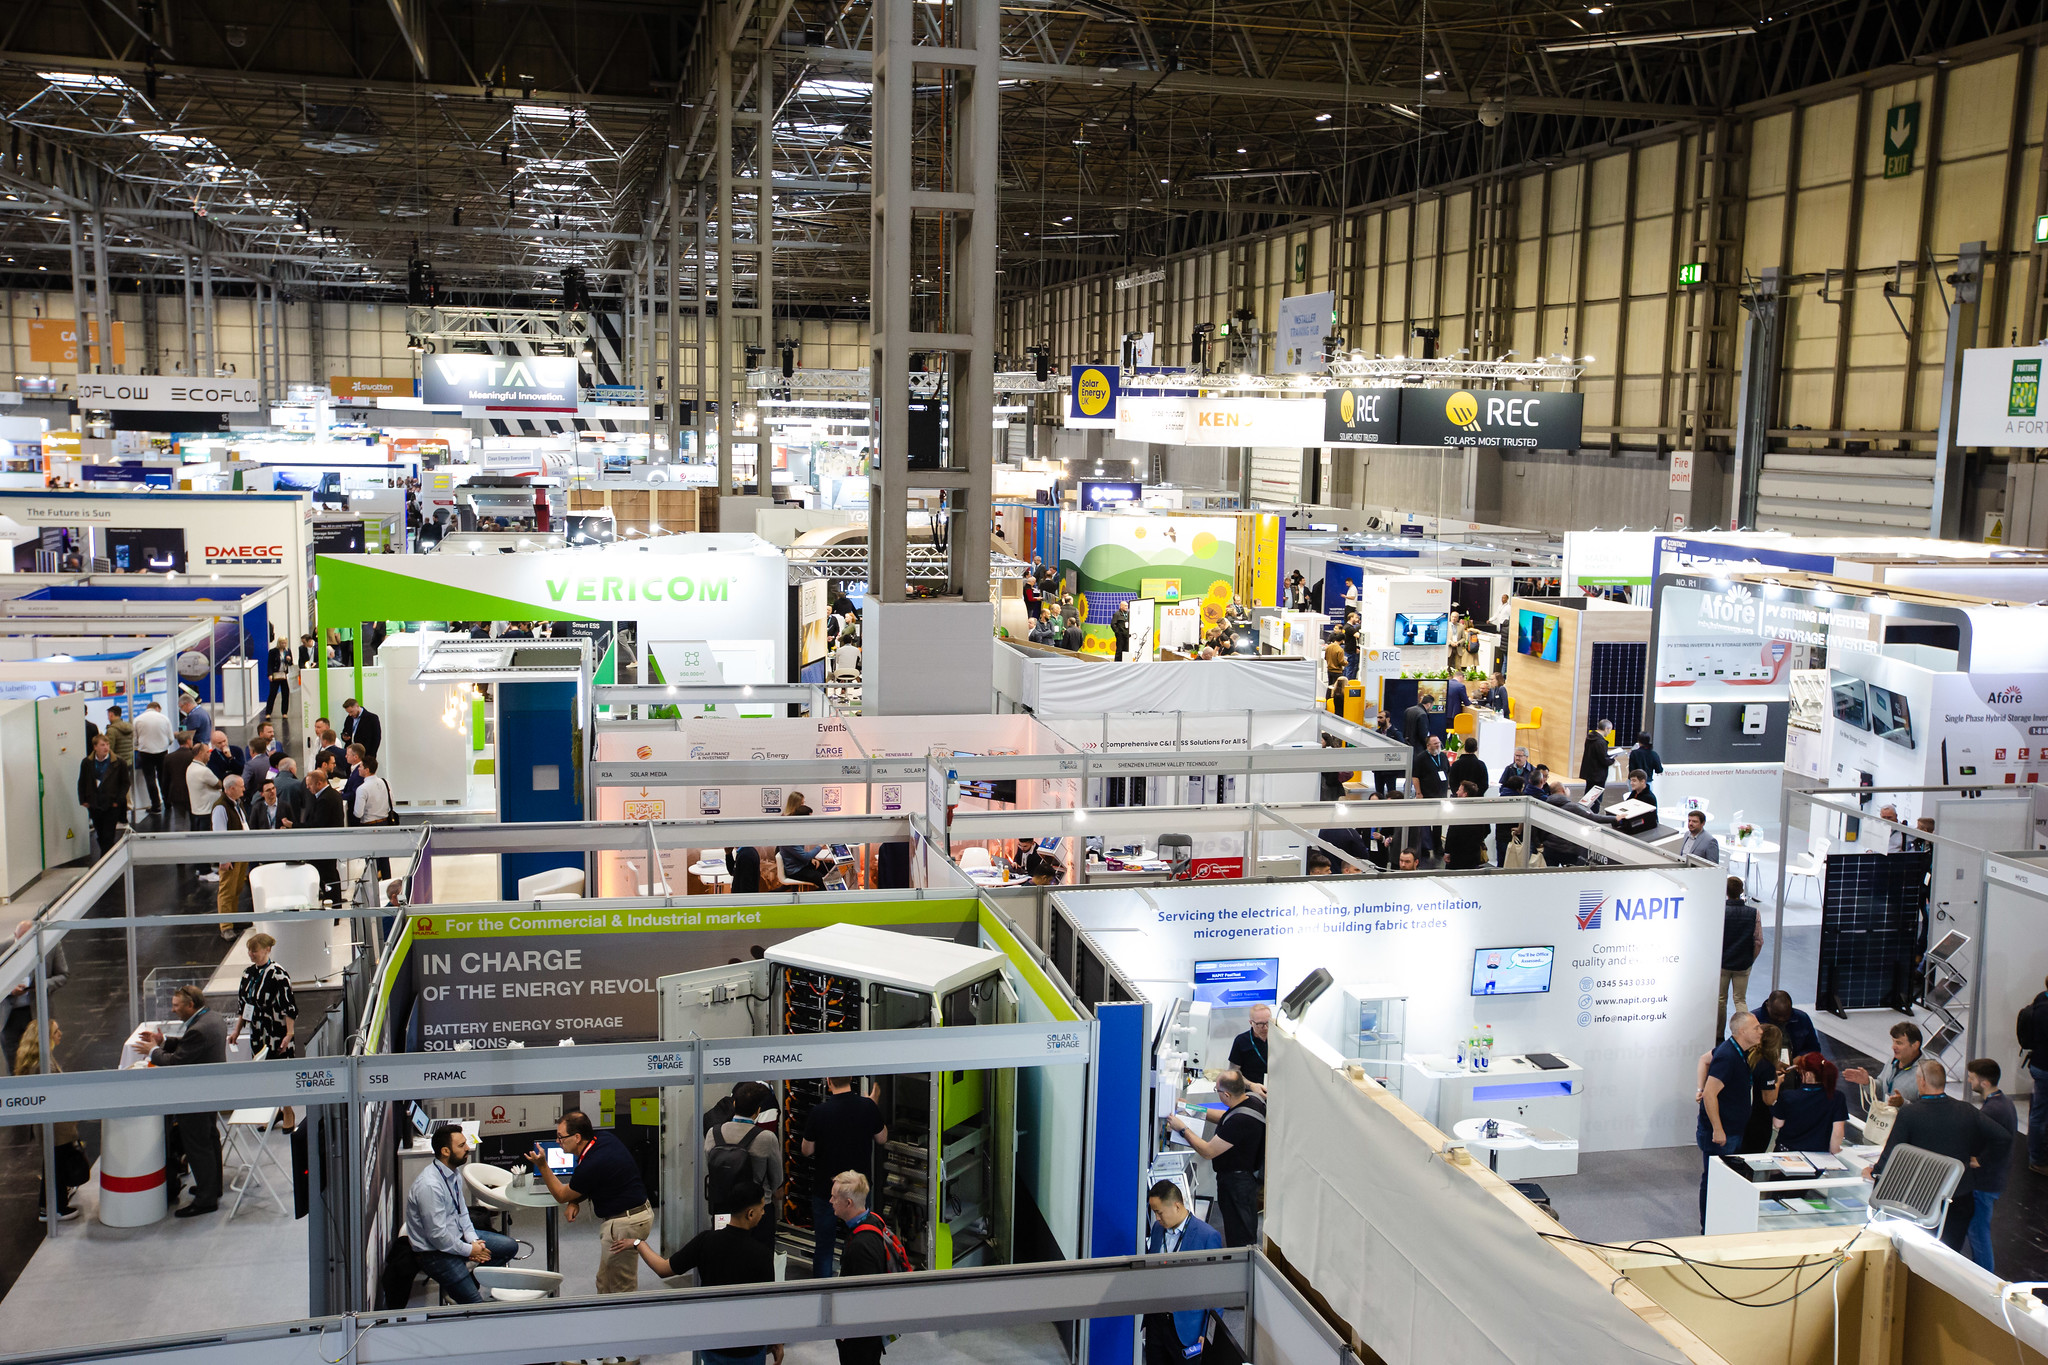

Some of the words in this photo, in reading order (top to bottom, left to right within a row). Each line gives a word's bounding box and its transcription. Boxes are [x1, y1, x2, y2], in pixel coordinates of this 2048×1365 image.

[1887, 154, 1910, 177] EXIT
[1081, 379, 1099, 388] Solar
[2013, 375, 2038, 383] GLOBAL
[171, 387, 257, 402] ECOFLO
[469, 391, 516, 401] Meaningful
[518, 391, 566, 401] Innovation.
[1081, 388, 1106, 399] Energy
[2010, 382, 2038, 408] 500
[1356, 395, 1381, 423] REC
[1486, 398, 1541, 427] REC
[1199, 412, 1254, 427] KEN
[2005, 421, 2014, 433] A
[1443, 436, 1476, 445] SOLAR'S
[1478, 437, 1500, 445] MOST
[1503, 438, 1537, 447] TRUSTED
[1674, 456, 1690, 470] Fire
[1671, 470, 1691, 485] point
[27, 508, 45, 516] The
[48, 508, 80, 517] Future
[82, 508, 90, 516] is
[92, 509, 111, 517] Sun
[1667, 539, 1687, 548] CONTACT
[205, 545, 283, 557] DMEGC
[545, 576, 729, 602] VERICOM
[839, 580, 856, 592] 1.6
[1675, 579, 1688, 587] NO.
[1167, 607, 1196, 616] KENO
[1700, 593, 1756, 624] Afore
[1765, 604, 1779, 617] PV
[1780, 607, 1817, 623] STRING
[1818, 612, 1870, 631] INVERTER
[1764, 625, 1778, 638] PV
[1779, 627, 1826, 646] STORAGE
[1826, 635, 1879, 653] INVERTER
[1382, 651, 1401, 661] REC
[1987, 691, 2022, 704] Afore
[1945, 714, 1964, 723] Single
[1965, 714, 1984, 722] Phase
[1985, 714, 2006, 723] Hybrid
[2007, 714, 2031, 723] Storage
[2033, 714, 2048, 722] Inver
[817, 723, 847, 733] Events
[766, 752, 789, 760] Energy
[1735, 768, 1777, 776] Manufacturing
[1158, 909, 1215, 923] Servicing
[1218, 908, 1238, 919] the
[1240, 905, 1299, 919] electrical,
[1302, 904, 1351, 917] heating,
[1353, 901, 1414, 917] plumbing,
[1416, 899, 1482, 912] ventilation,
[1615, 896, 1685, 921] NAPIT
[446, 918, 473, 932] For
[477, 918, 504, 931] the
[509, 913, 607, 930] Commercial
[611, 914, 623, 927] &
[627, 911, 702, 926] Industrial
[705, 911, 762, 925] market
[1194, 924, 1294, 939] microgeneration
[1323, 920, 1372, 934] building
[1375, 919, 1408, 931] fabric
[1411, 917, 1447, 930] trades
[423, 953, 451, 975] IN
[461, 949, 582, 974] CHARGE
[1572, 957, 1606, 969] quality
[1608, 956, 1627, 966] and
[1596, 980, 1617, 988] 0345
[1619, 979, 1633, 987] 543
[1635, 978, 1656, 986] 0330
[423, 985, 452, 1001] OF
[456, 983, 496, 1000] THE
[502, 980, 585, 998] ENERGY
[590, 978, 661, 994] REVOL
[1595, 994, 1668, 1005] www.napit.org.uk
[1594, 1012, 1667, 1023] info@napit.org.uk
[424, 1022, 489, 1036] BATTERY
[493, 1019, 551, 1033] ENERGY
[556, 1016, 623, 1030] STORAGE
[1046, 1034, 1071, 1042] SOLAR
[423, 1037, 508, 1052] SOLUTIONS
[1046, 1041, 1080, 1050] STORAGE
[647, 1054, 674, 1063] SOLAR
[712, 1057, 731, 1067] S5B
[763, 1053, 803, 1064] PRAMAC
[647, 1061, 684, 1071] STORAGE
[295, 1071, 325, 1080] SOLAR
[325, 1070, 333, 1078] &
[369, 1074, 389, 1085] S5B
[423, 1070, 467, 1081] PRAMAC
[295, 1078, 335, 1088] STORAGE
[6, 1096, 46, 1108] GROUP
